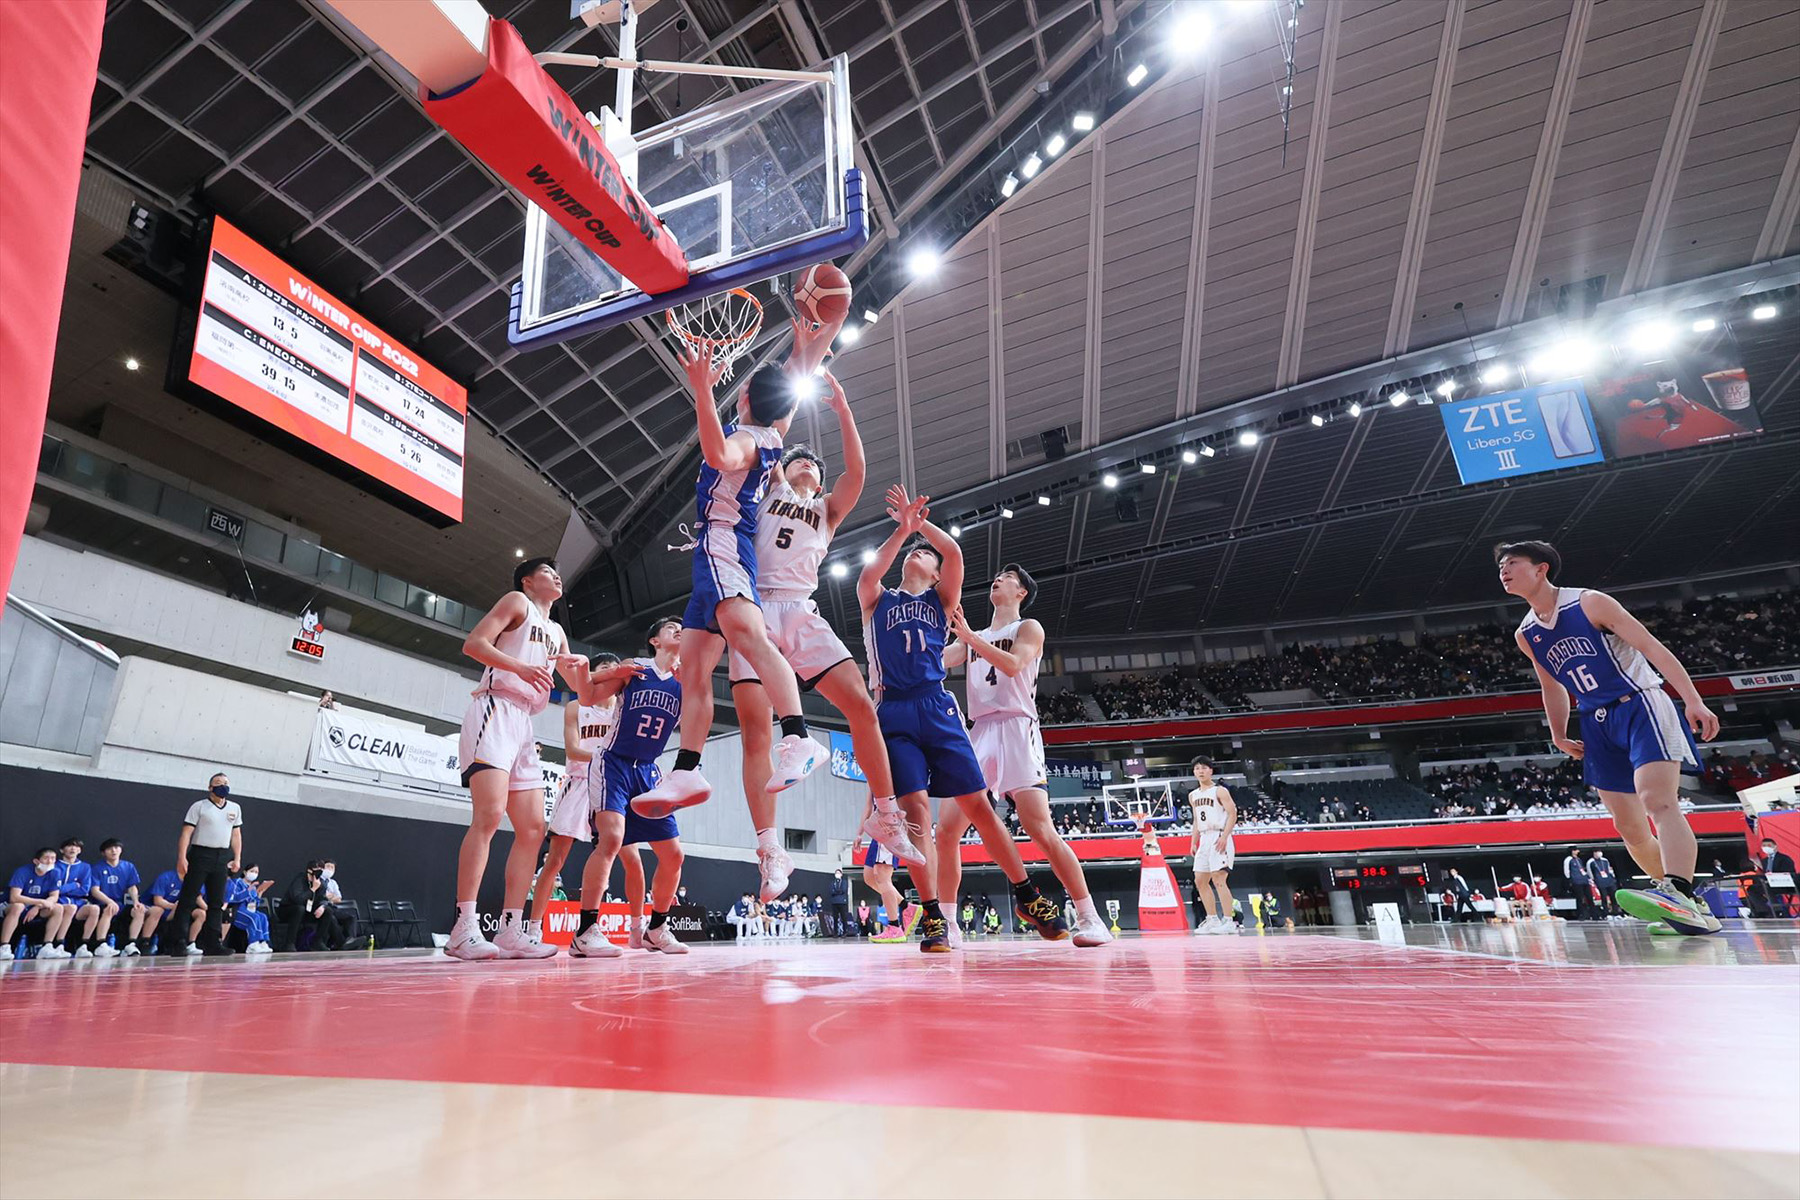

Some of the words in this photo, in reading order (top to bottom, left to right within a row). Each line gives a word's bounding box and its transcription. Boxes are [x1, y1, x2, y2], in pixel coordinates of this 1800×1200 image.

[585, 218, 621, 248] CUP
[351, 322, 382, 349] CUP
[382, 342, 419, 379] 2022
[1458, 399, 1527, 433] ZTE
[1467, 435, 1512, 451] Libero
[1513, 429, 1536, 445] 5G
[775, 527, 795, 550] 5
[886, 600, 938, 631] HAGURO
[295, 641, 323, 656] 12:05
[902, 628, 926, 654] 11
[1546, 636, 1598, 675] HAGURO
[985, 665, 997, 686] 4
[1566, 664, 1599, 694] 16
[629, 690, 679, 717] HAGURO
[636, 714, 665, 740] 23
[348, 733, 406, 759] CLEAN
[1200, 811, 1207, 821] 8
[1362, 867, 1387, 877] 38.6
[599, 914, 624, 932] CUP
[671, 915, 703, 931] SoftBank
[1382, 907, 1394, 921] A
